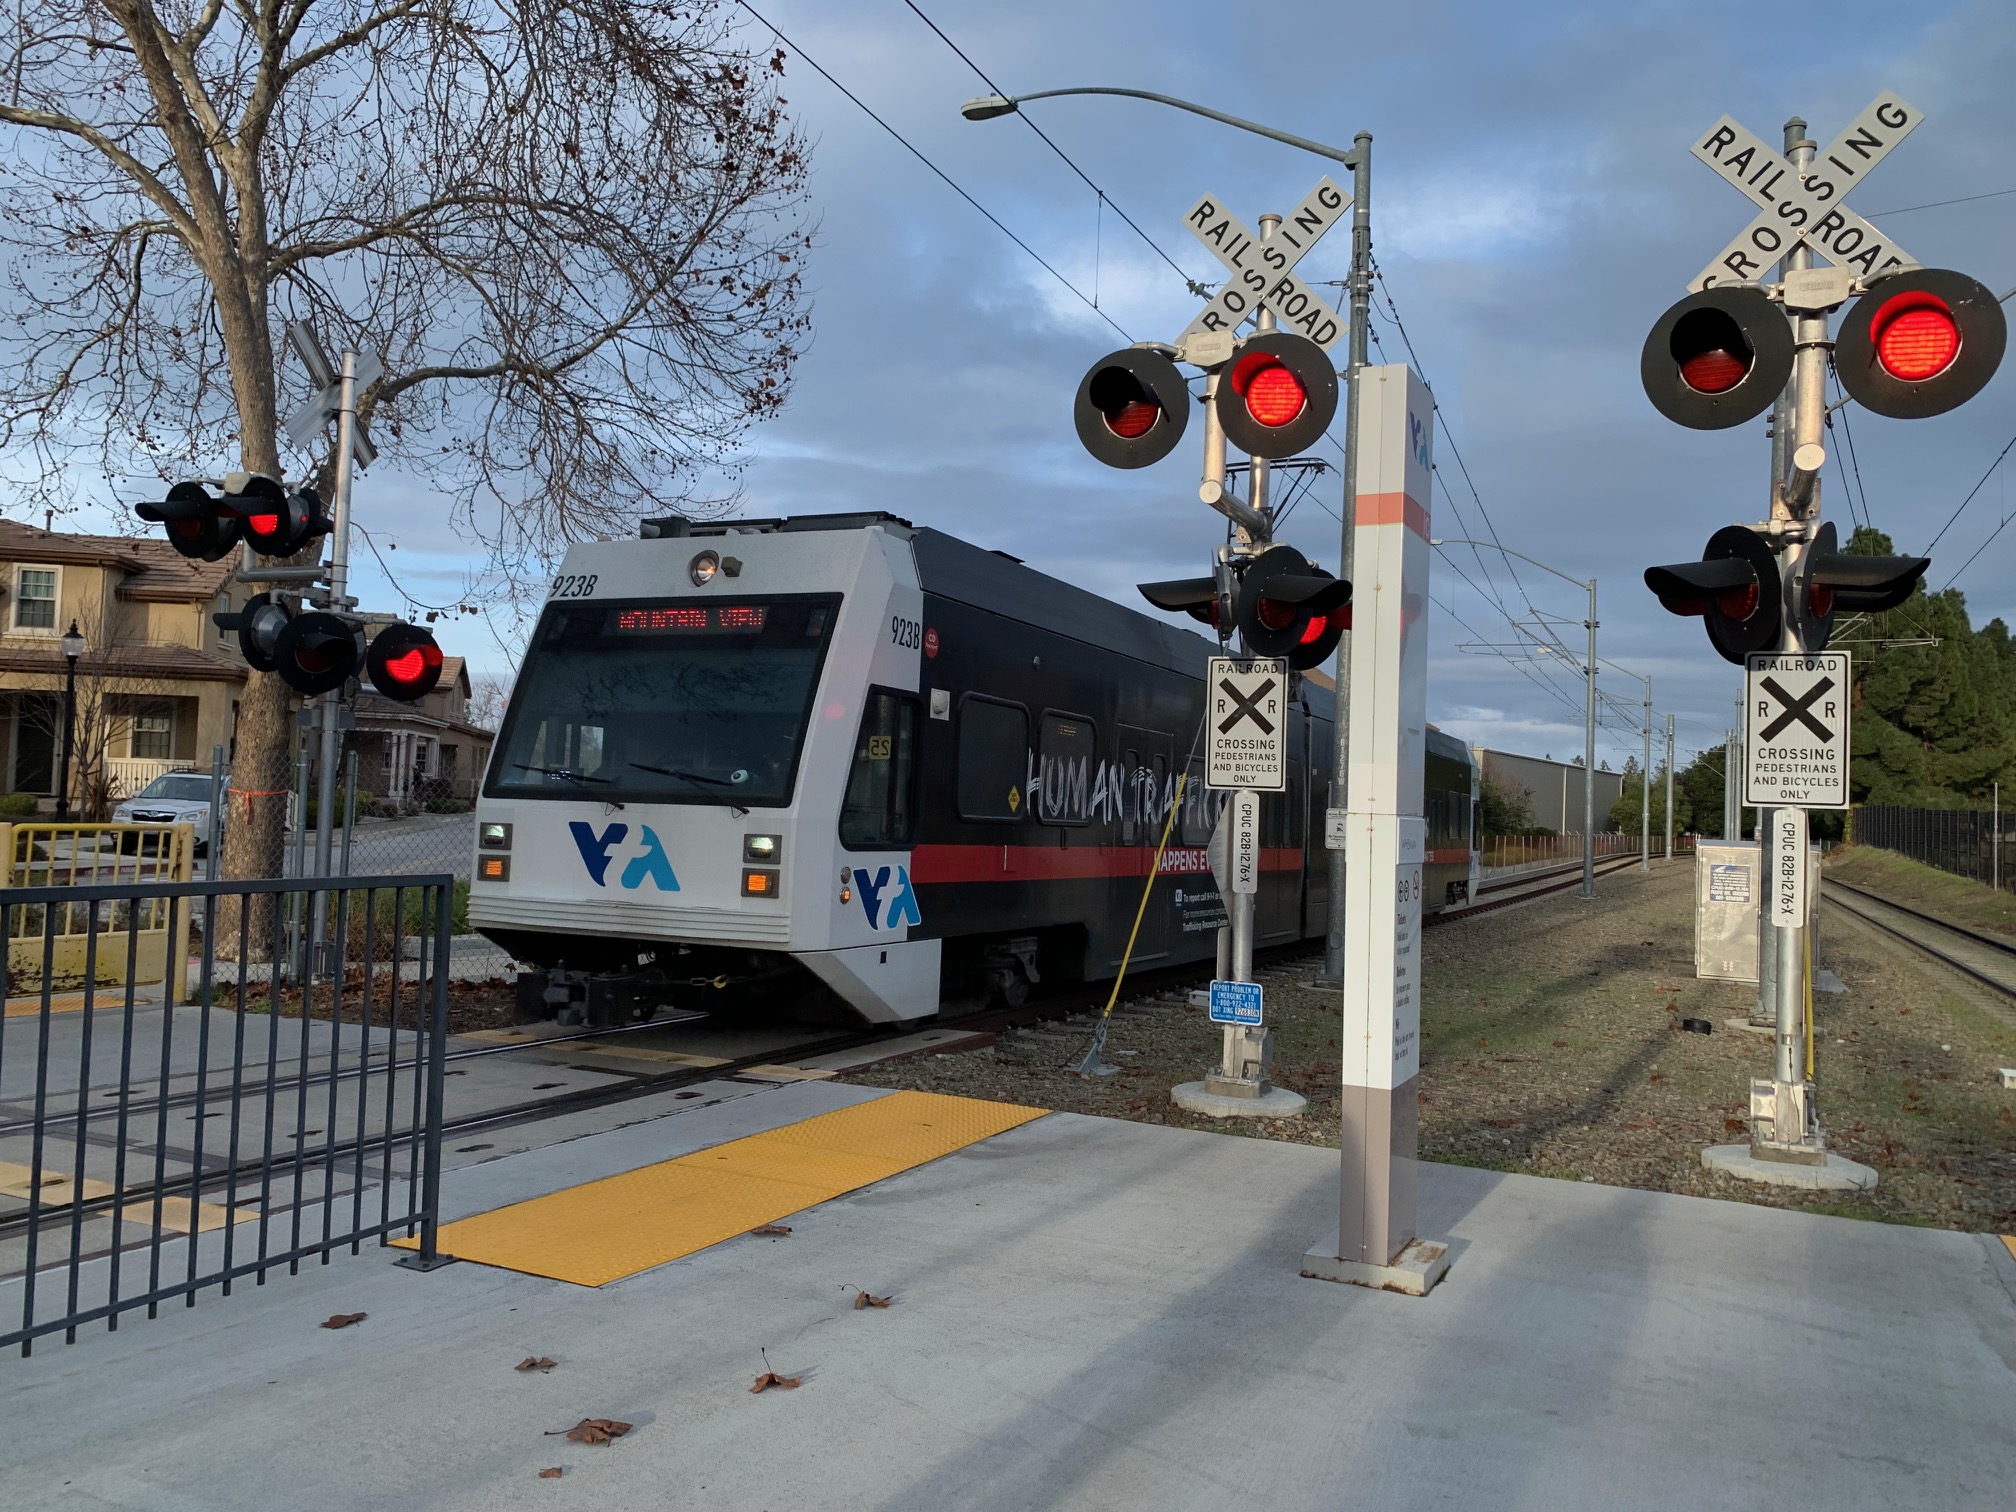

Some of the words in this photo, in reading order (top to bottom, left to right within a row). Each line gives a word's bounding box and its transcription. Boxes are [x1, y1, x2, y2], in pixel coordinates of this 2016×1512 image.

[1190, 187, 1342, 334] ROSSING
[550, 574, 598, 597] 923B
[891, 615, 920, 650] 923B
[1218, 664, 1279, 674] RAILROAD
[1758, 660, 1837, 671] RAILROAD
[1217, 699, 1226, 713] R
[1268, 699, 1277, 714] R
[1758, 701, 1769, 718] R
[1825, 702, 1836, 718] R
[1217, 739, 1275, 750] CROSSING
[1215, 752, 1277, 761] PEDESTRIANS
[1758, 748, 1835, 760] CROSSING
[1213, 763, 1232, 771] AND
[1235, 764, 1278, 773] BICYCLES
[1756, 763, 1837, 774] PEDESTRIANS
[1233, 775, 1256, 783] ONLY
[1754, 777, 1777, 785] AND
[1782, 777, 1839, 787] BICYCLES
[1026, 748, 1125, 825] HUMAN
[1780, 790, 1810, 799] ONLY
[1241, 803, 1252, 828] CPUC
[1782, 822, 1796, 852] CPUC
[1213, 984, 1230, 992] REPORT
[1231, 985, 1252, 994] PROBLEM
[1253, 987, 1259, 995] OR
[1217, 992, 1246, 1001] EMERGENCY
